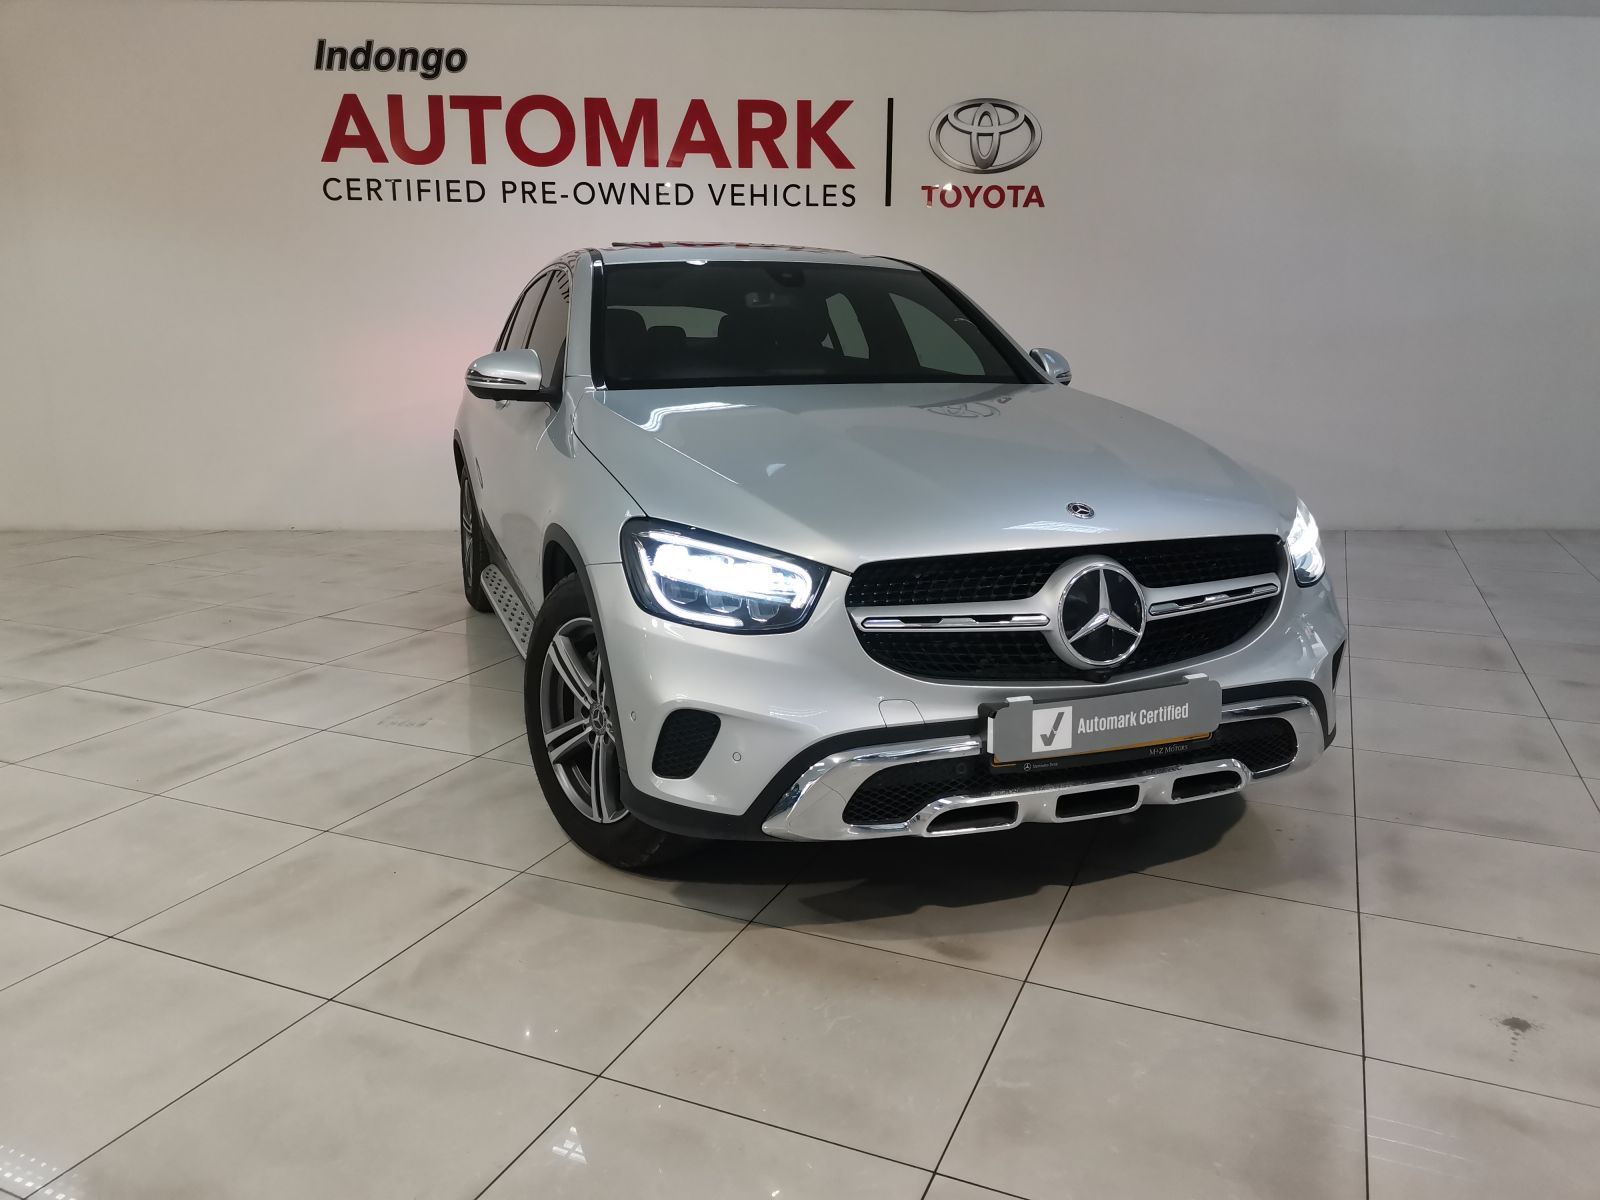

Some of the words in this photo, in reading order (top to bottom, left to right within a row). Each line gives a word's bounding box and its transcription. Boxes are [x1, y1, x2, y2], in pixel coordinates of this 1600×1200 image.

[314, 38, 468, 80] Indongo
[321, 93, 856, 170] AUTOMARK
[322, 177, 486, 203] CERTIFIED
[501, 180, 694, 206] PRE-OWNED
[707, 183, 856, 207] VEHICLES
[920, 184, 1046, 209] TOYOTA
[1077, 709, 1137, 734] Automark
[1139, 702, 1189, 725] Certified
